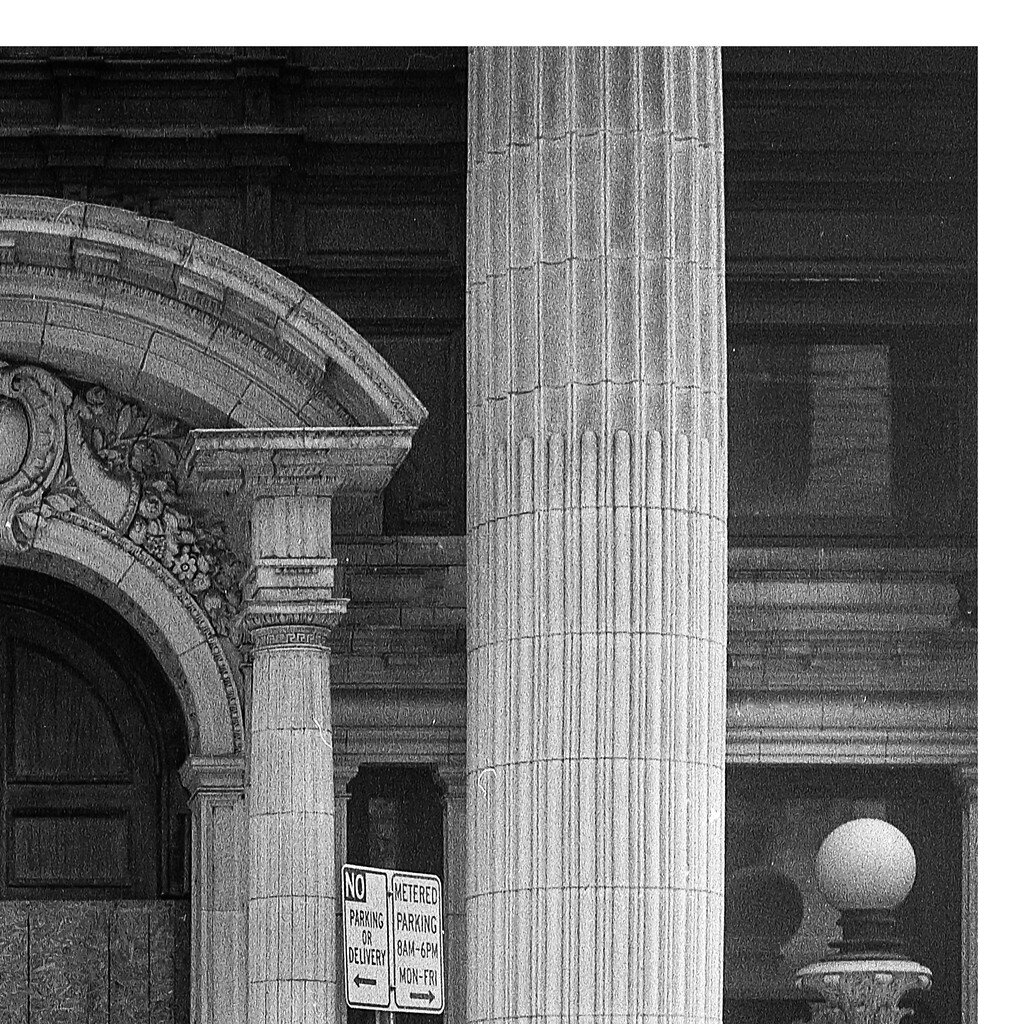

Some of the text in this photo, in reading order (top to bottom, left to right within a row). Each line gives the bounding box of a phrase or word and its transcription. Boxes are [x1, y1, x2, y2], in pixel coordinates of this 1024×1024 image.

[345, 871, 365, 900] NO
[394, 882, 438, 905] METERED
[349, 909, 384, 929] PARKING
[396, 912, 437, 934] PARKING
[362, 930, 372, 946] OR
[349, 947, 386, 966] DELIVERY
[397, 940, 438, 959] 8AM-6PM
[399, 967, 438, 986] MON-FRI
